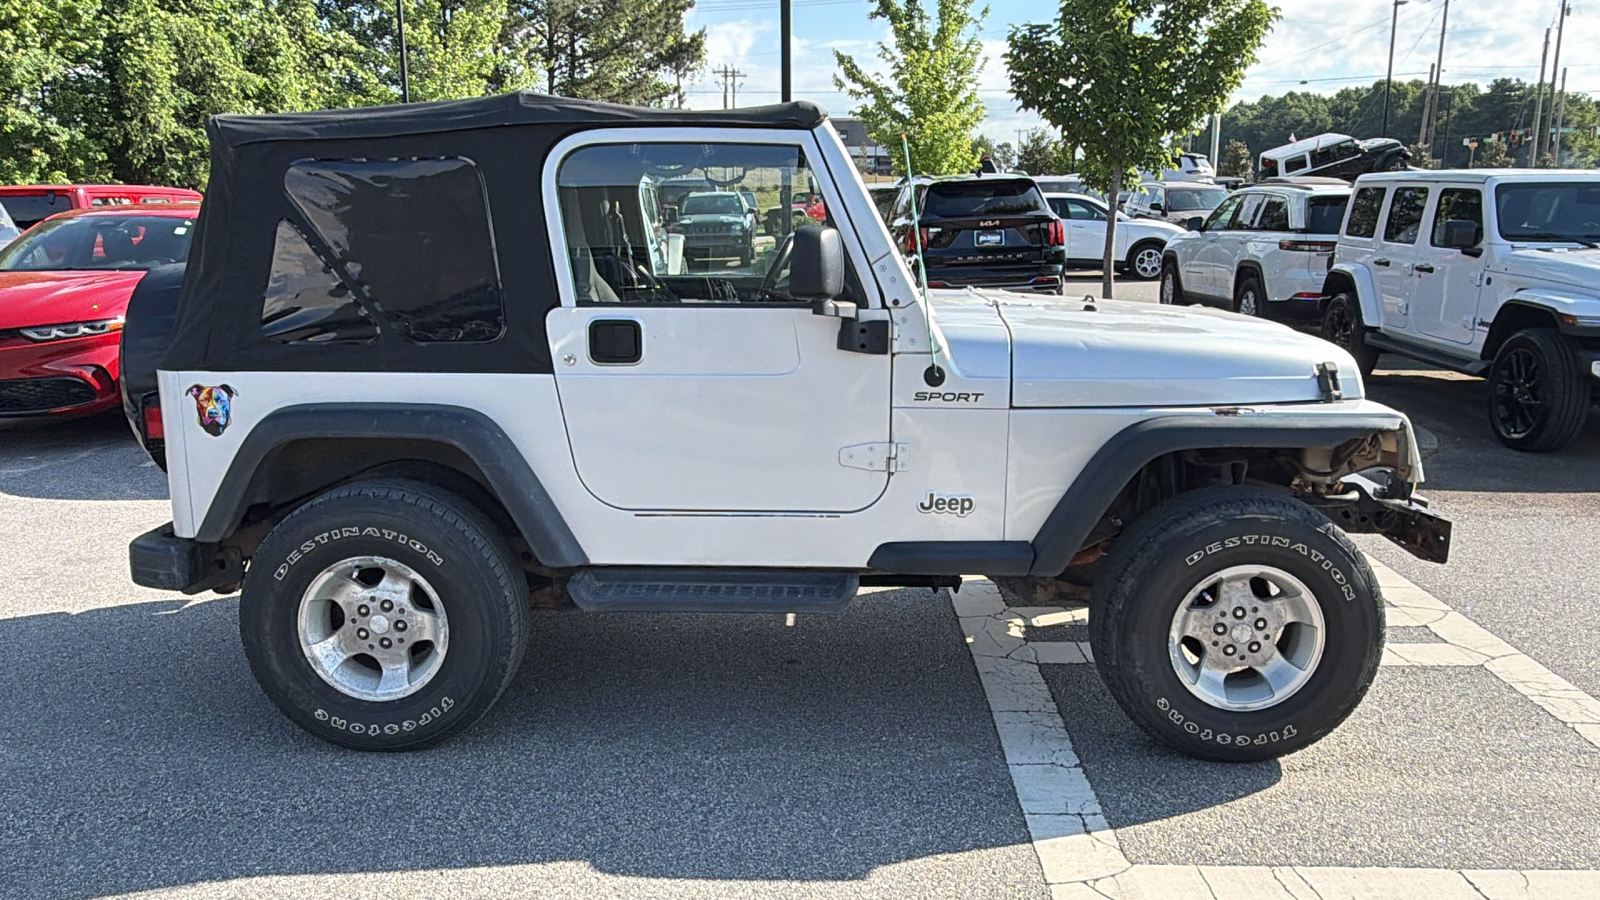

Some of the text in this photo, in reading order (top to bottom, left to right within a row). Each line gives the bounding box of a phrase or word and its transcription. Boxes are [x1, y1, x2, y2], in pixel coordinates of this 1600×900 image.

[913, 391, 985, 403] SPORT
[919, 492, 974, 515] Jeep
[273, 526, 444, 581] DESTINATION
[1185, 534, 1356, 601] DESTINATION
